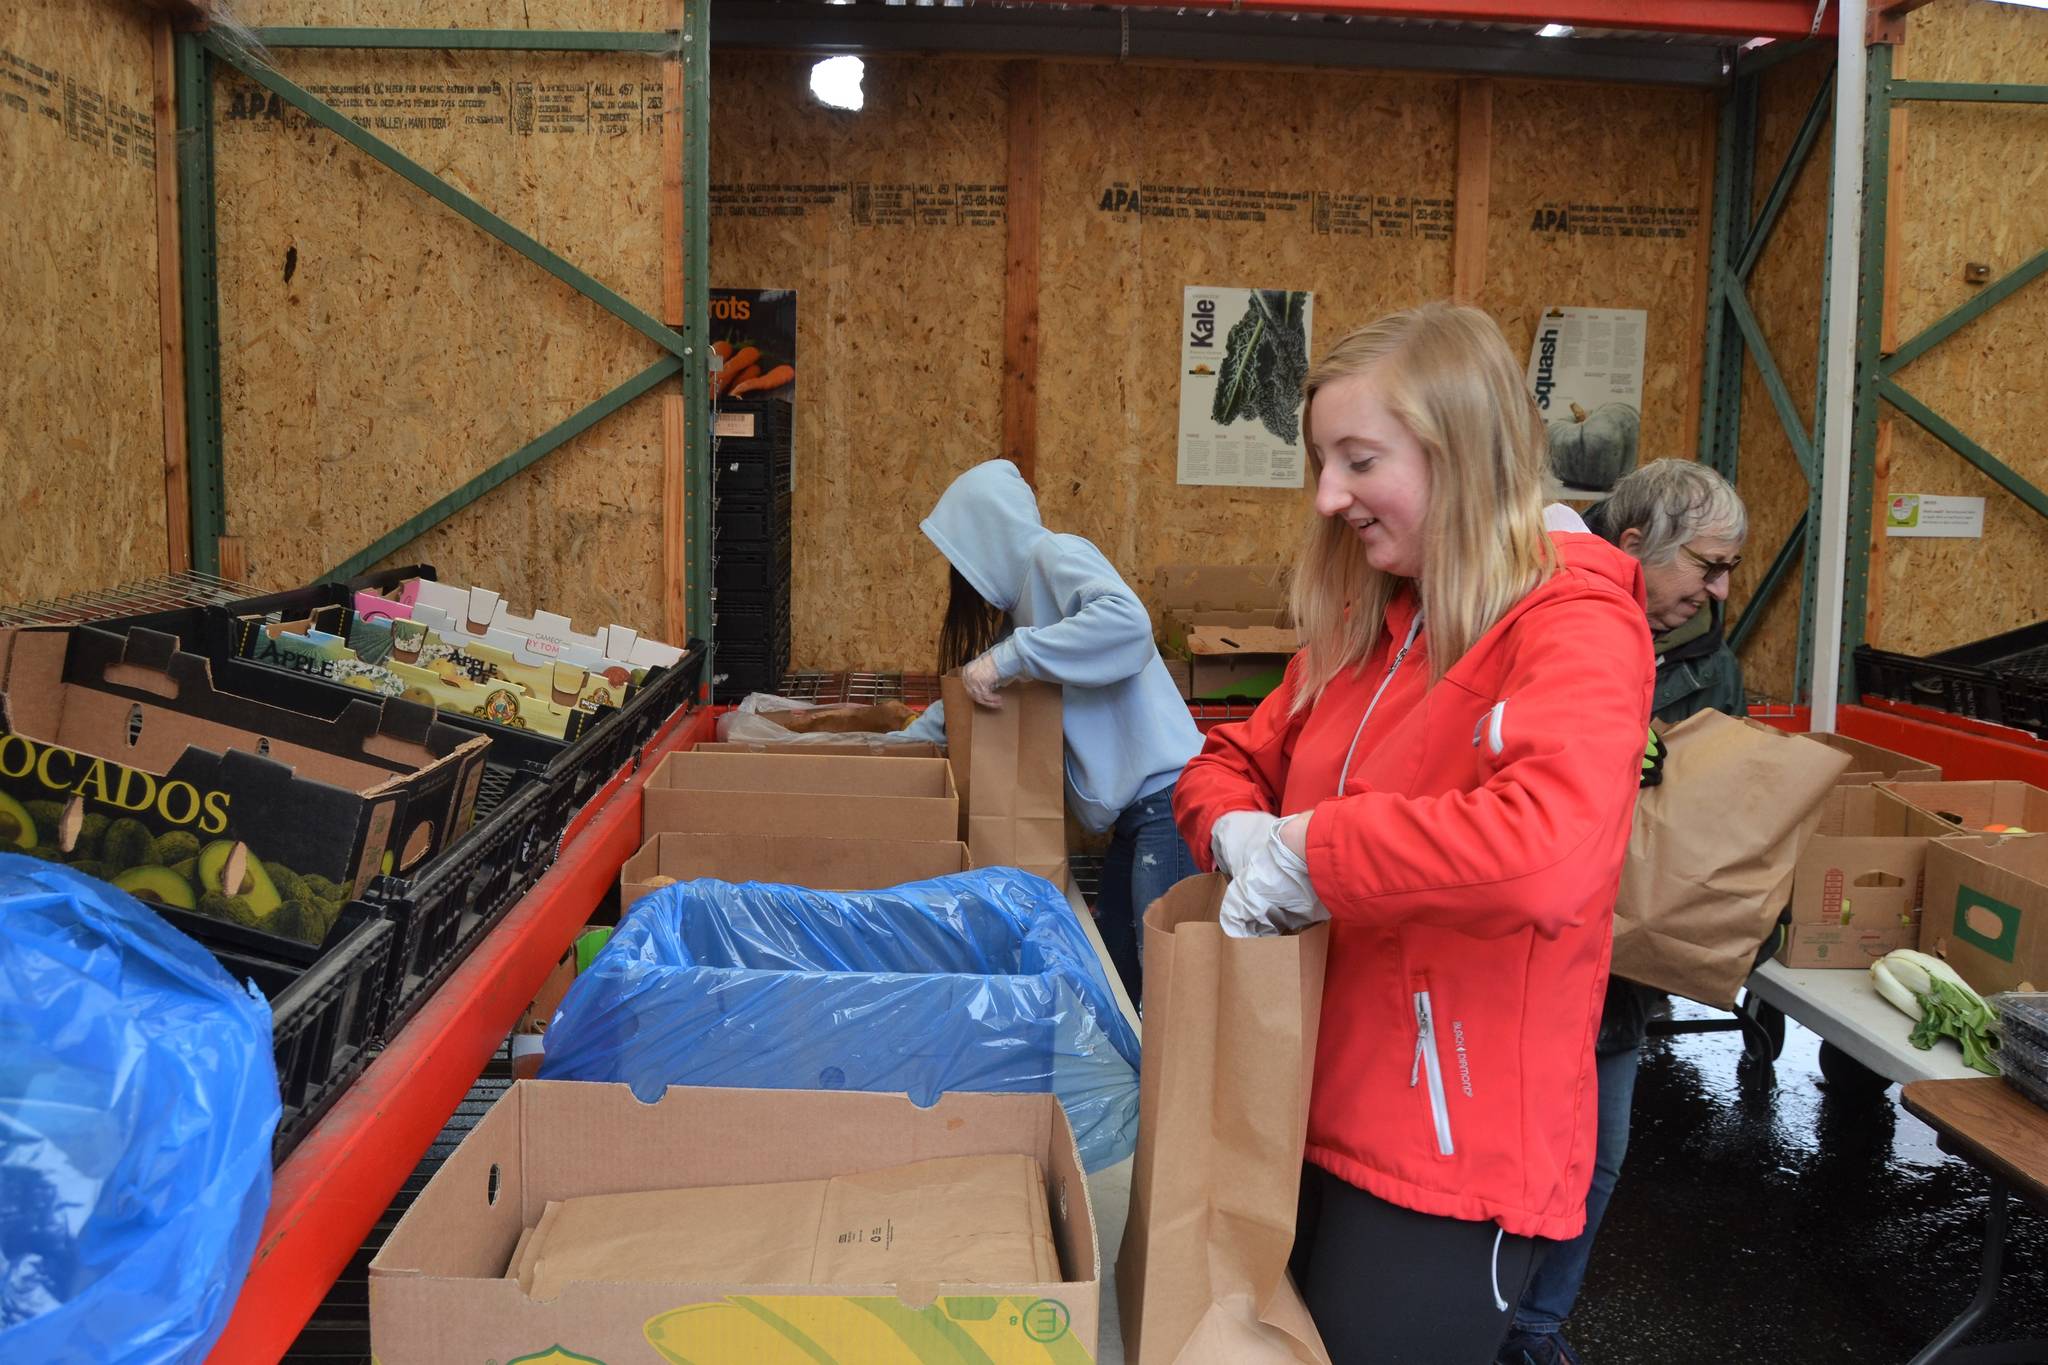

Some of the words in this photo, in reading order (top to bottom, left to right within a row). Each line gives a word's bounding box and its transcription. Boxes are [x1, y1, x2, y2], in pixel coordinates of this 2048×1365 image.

[1098, 188, 1140, 212] APA
[1531, 209, 1568, 232] APA
[1190, 299, 1215, 348] Kale
[259, 640, 335, 679] APPLE
[447, 649, 498, 675] APPLE
[1453, 1021, 1464, 1047] BLACK
[1037, 1308, 1056, 1333] E
